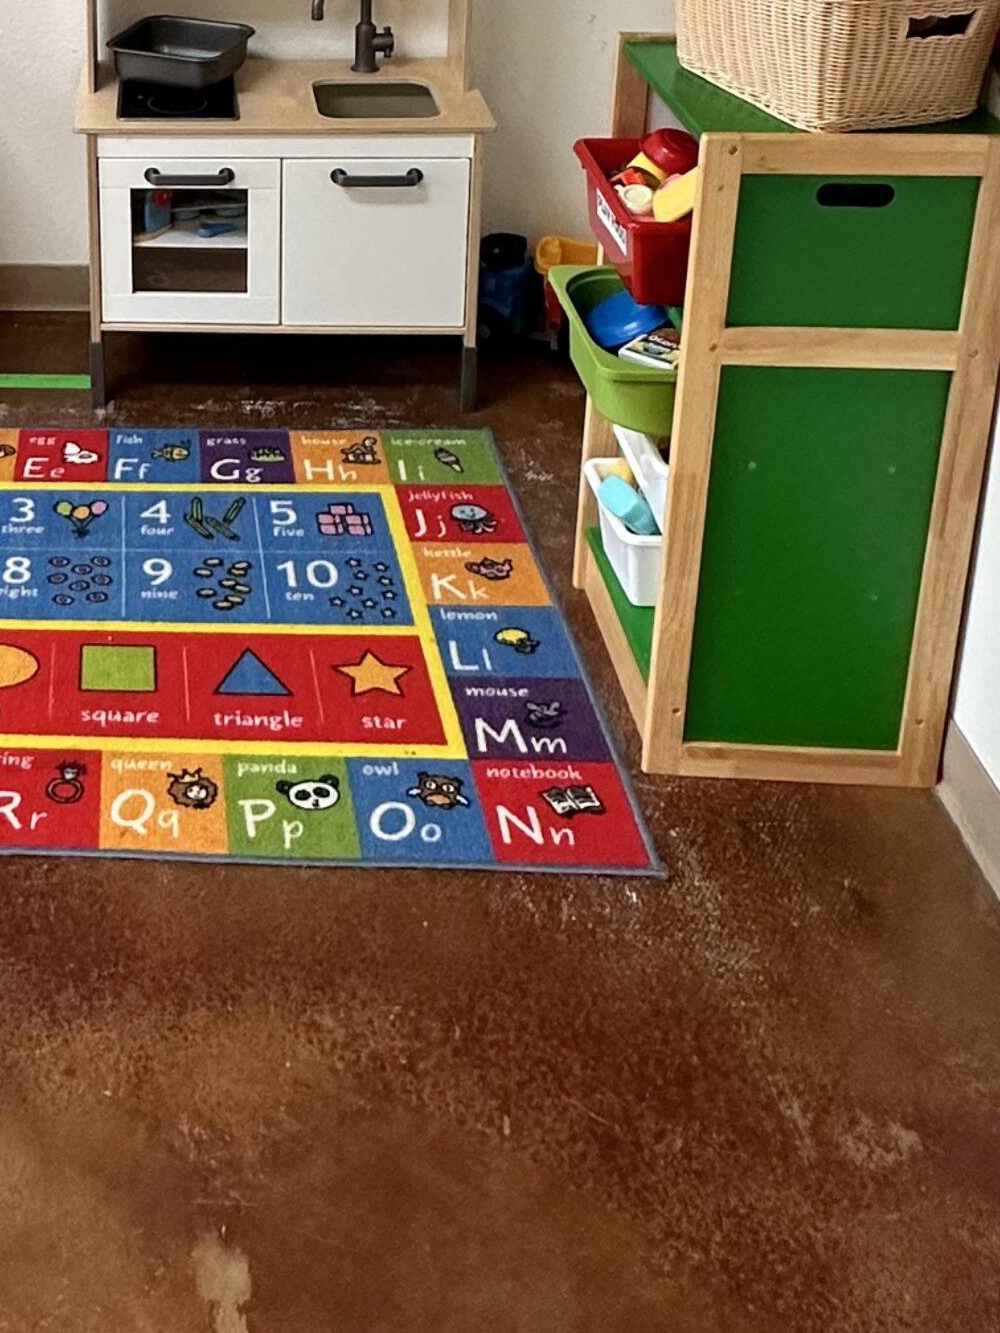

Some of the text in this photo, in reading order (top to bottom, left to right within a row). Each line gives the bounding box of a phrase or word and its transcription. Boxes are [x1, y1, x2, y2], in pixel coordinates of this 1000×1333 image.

[29, 436, 57, 446] egg
[206, 436, 247, 446] grass
[9, 497, 35, 523] 3
[140, 499, 171, 524] 4
[269, 500, 297, 525] 5
[1, 524, 45, 535] three
[140, 525, 174, 536] four
[423, 547, 471, 558] kettle
[2, 556, 31, 584] 8
[142, 557, 173, 585] 9
[276, 560, 339, 588] 10
[141, 589, 179, 599] nine
[285, 592, 315, 601] ten
[440, 608, 498, 621] lemon
[464, 686, 530, 698] mouse
[81, 709, 159, 727] square
[213, 710, 304, 731] triangle
[361, 716, 407, 729] star
[111, 758, 173, 772] queen
[237, 759, 297, 777] panda
[362, 762, 399, 776] owl
[486, 765, 582, 780] notebook
